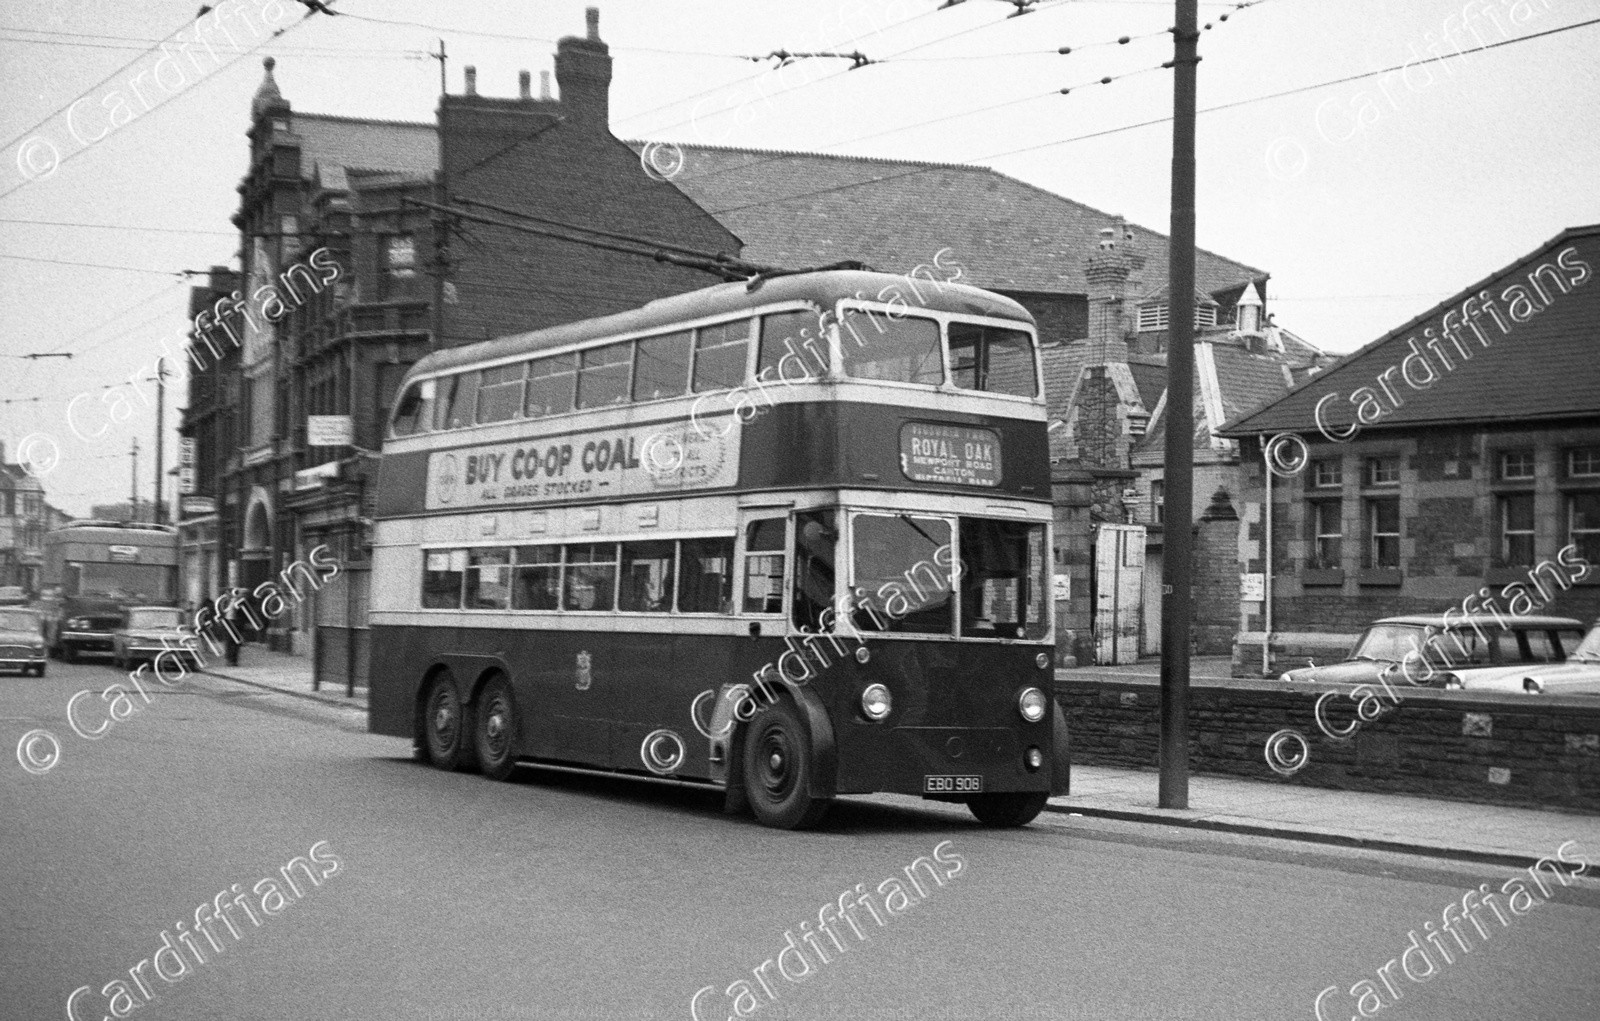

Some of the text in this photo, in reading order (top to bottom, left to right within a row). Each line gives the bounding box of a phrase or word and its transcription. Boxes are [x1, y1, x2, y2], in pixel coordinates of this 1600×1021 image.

[911, 437, 992, 461] ROYAL OAK
[465, 453, 506, 485] BUY
[511, 444, 572, 480] CO-OP
[582, 436, 639, 473] COAL
[965, 461, 992, 471] ROAD
[544, 480, 593, 496] STOCKED
[955, 777, 980, 791] 908
